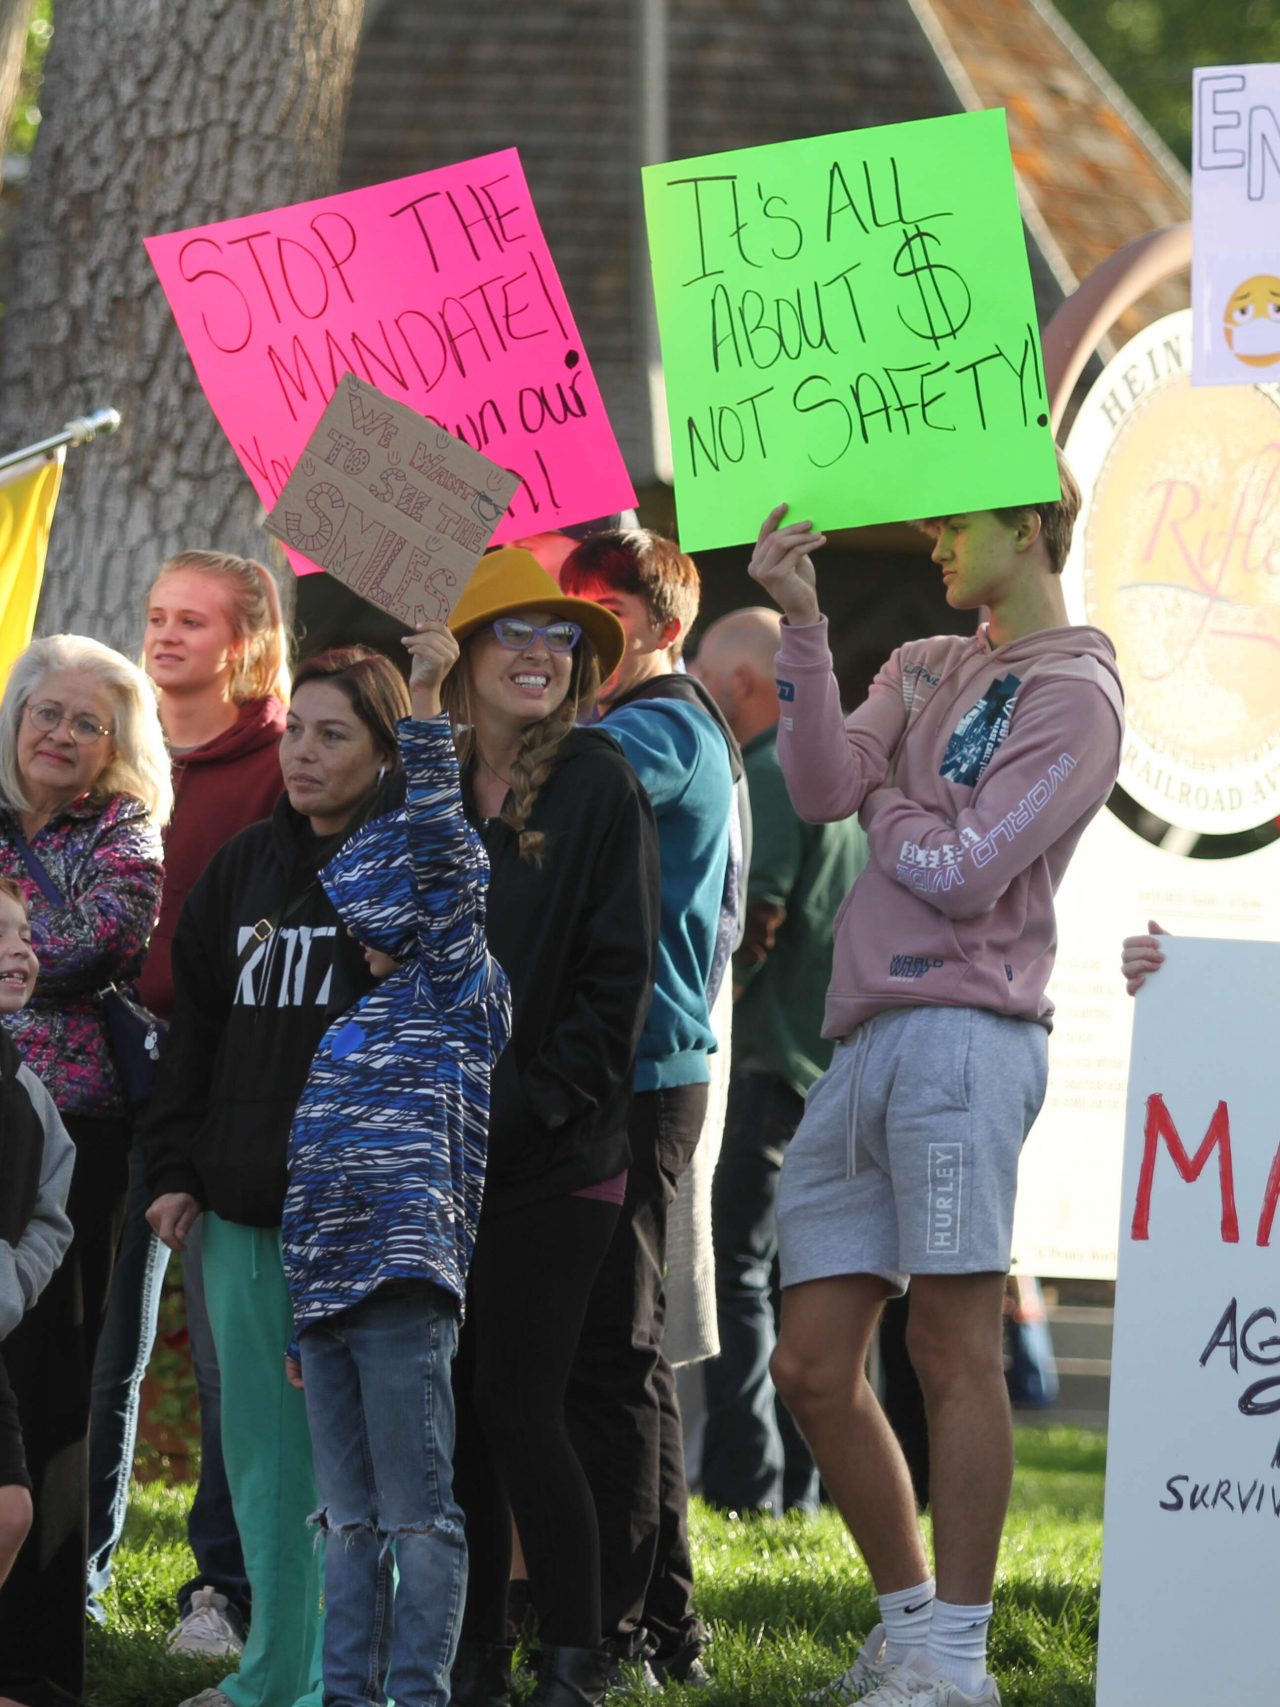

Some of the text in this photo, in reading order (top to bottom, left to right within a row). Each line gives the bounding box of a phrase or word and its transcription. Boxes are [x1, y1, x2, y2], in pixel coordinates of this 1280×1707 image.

[826, 156, 954, 243] ALL
[178, 174, 528, 354] STOP THE
[711, 223, 973, 374] ABOUT $
[267, 250, 581, 422] MANDATE!
[519, 370, 588, 434] our
[687, 322, 1049, 478] NOT SAFETY!
[325, 427, 488, 554] TO SEE THE
[409, 441, 480, 502] WANT
[285, 481, 457, 627] SMILES
[972, 753, 1077, 869] WORLD
[1124, 743, 1243, 811] RAILROAD
[1253, 764, 1280, 804] AV
[934, 1151, 953, 1247] HURLEY
